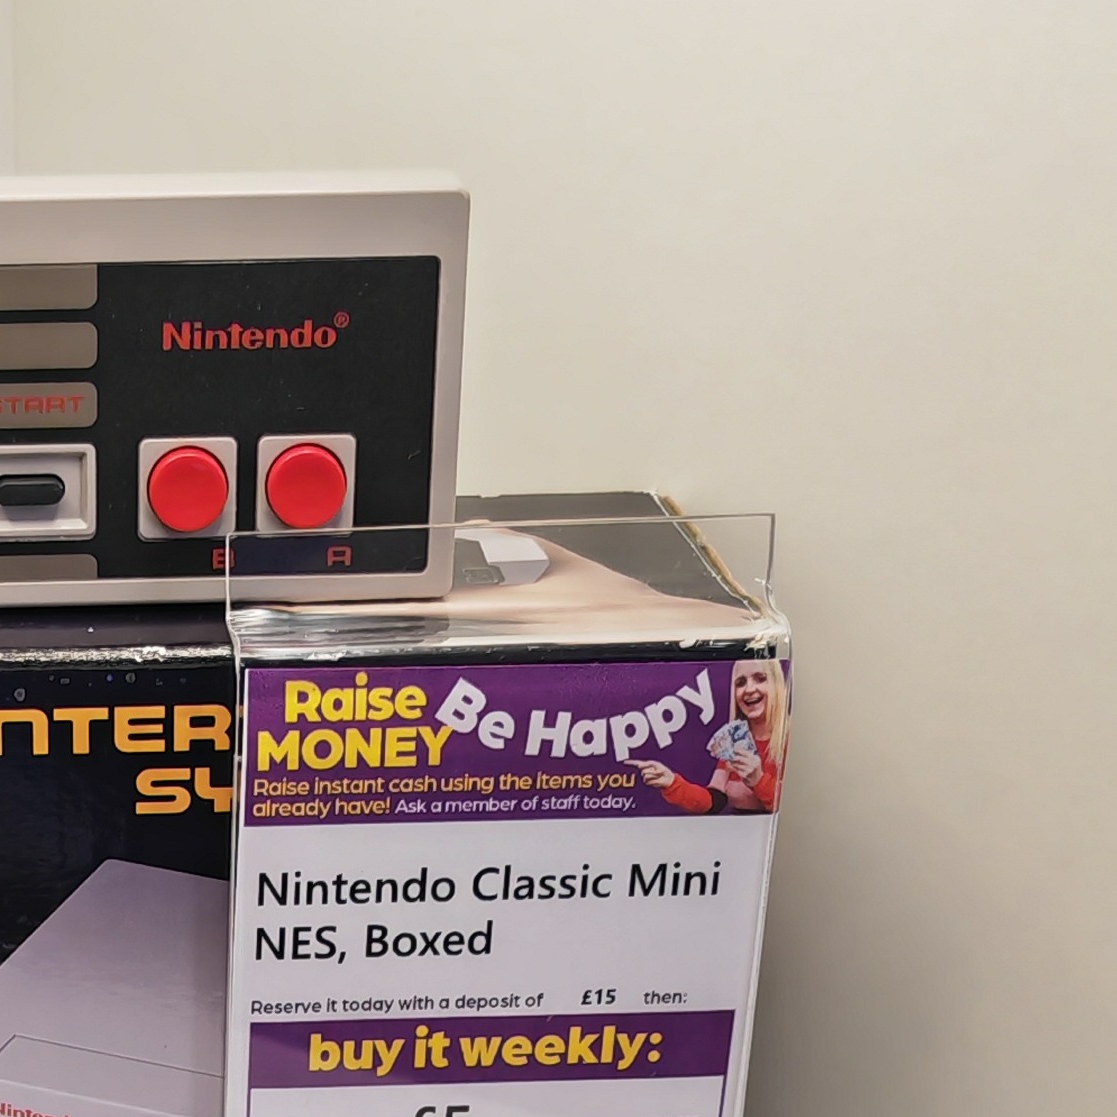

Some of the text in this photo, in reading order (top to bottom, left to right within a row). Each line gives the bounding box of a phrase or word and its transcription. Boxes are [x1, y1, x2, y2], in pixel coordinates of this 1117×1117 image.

[212, 548, 235, 569] B
[327, 546, 352, 567] A
[284, 671, 427, 724] Raise
[435, 668, 716, 763] Be Happy
[257, 726, 453, 771] MONEY
[253, 771, 636, 797] Raise instant cash using the items you
[253, 793, 636, 819] already have! Ask a member of staff today.
[257, 860, 722, 906] Nintendo Classic Mini
[254, 919, 493, 964] NES, Boxed
[250, 988, 687, 1016] Reserve it today with a deposit of £15 then:
[308, 1024, 663, 1077] buy it weekly:
